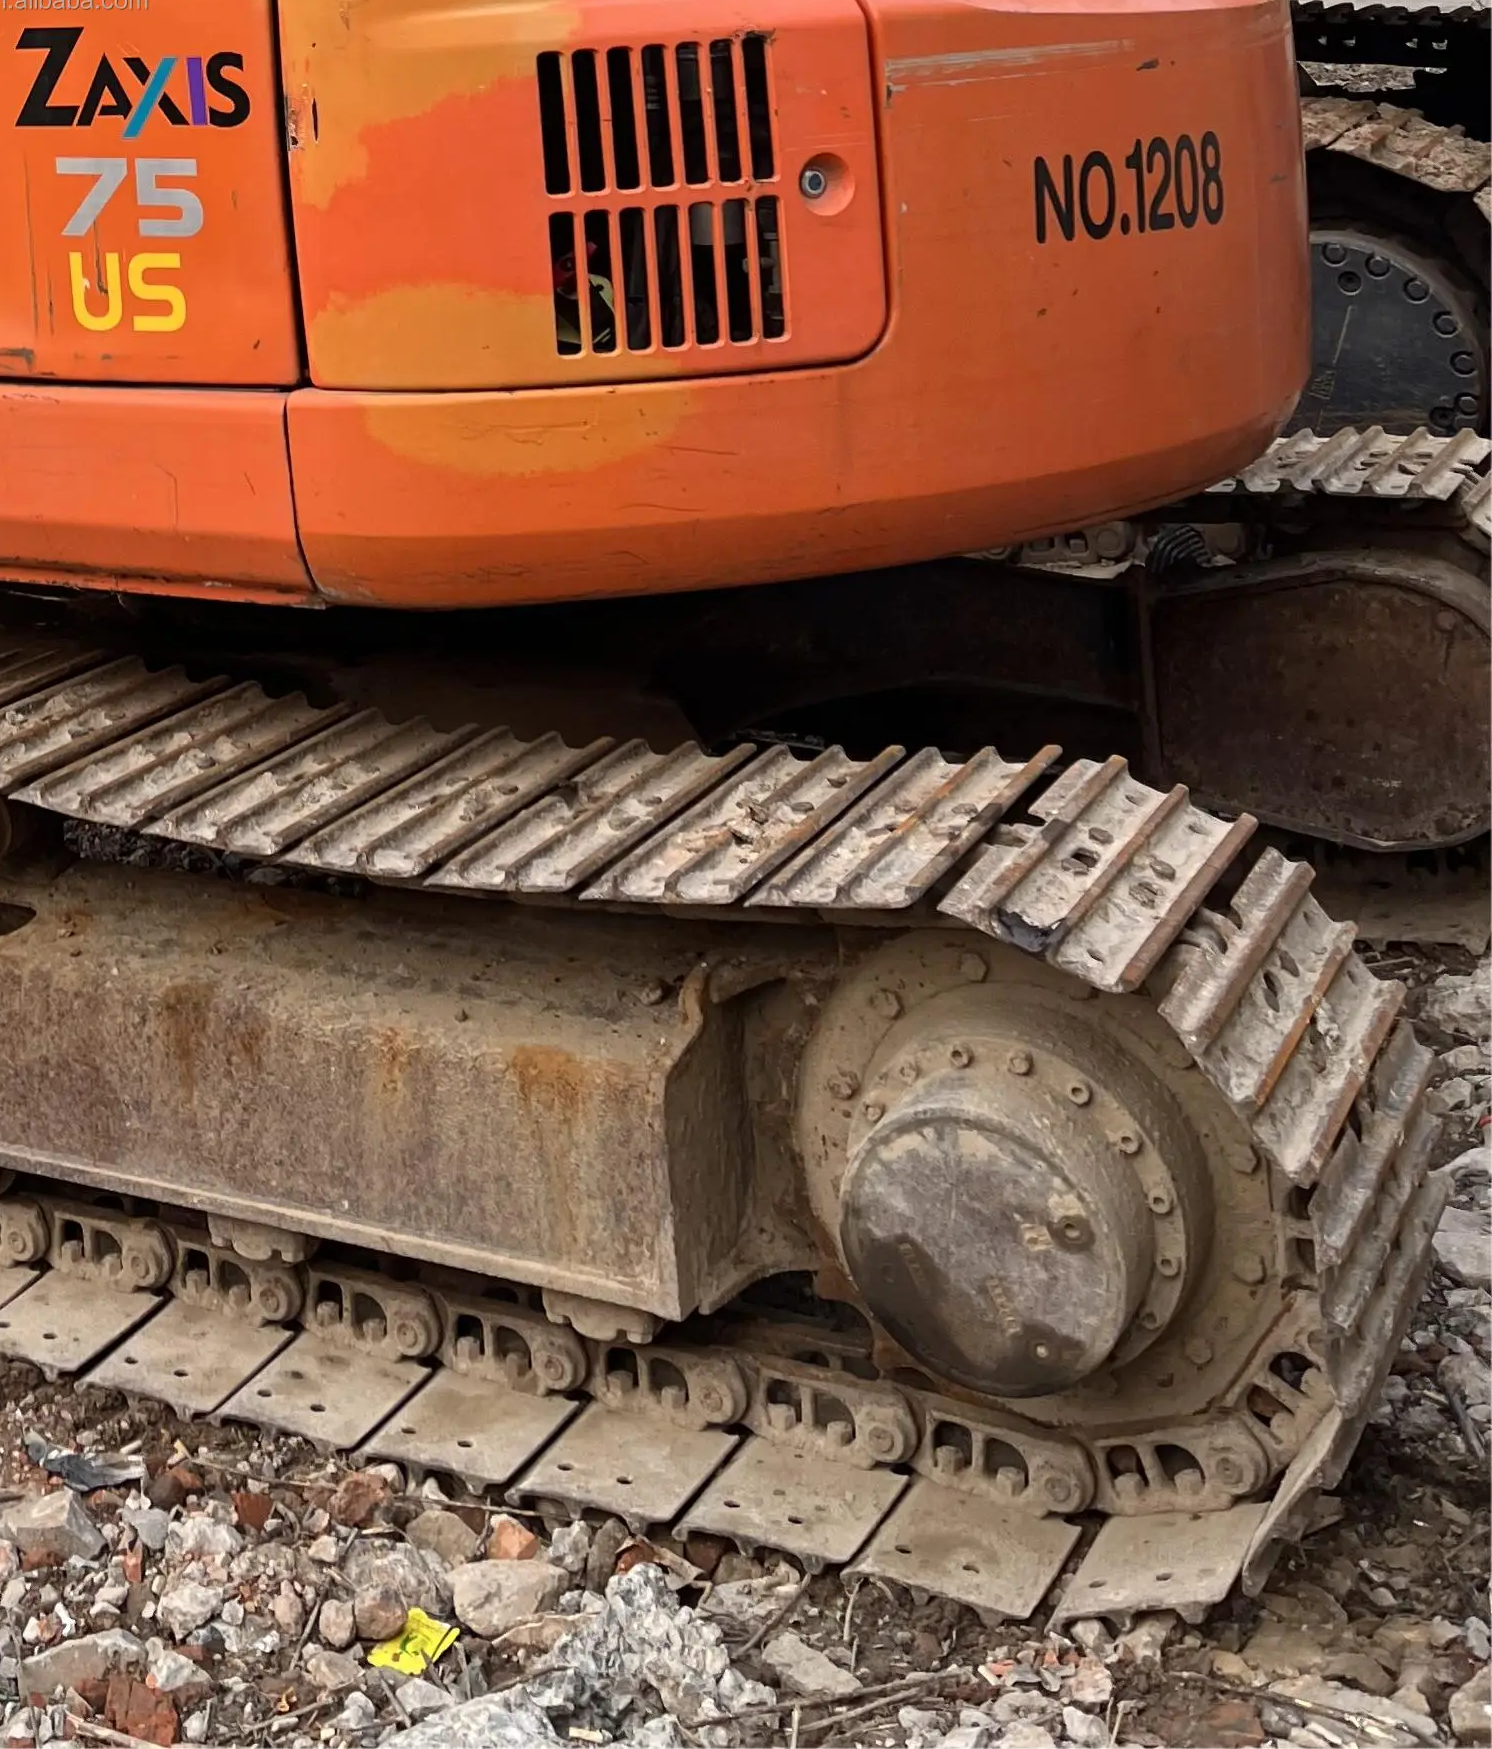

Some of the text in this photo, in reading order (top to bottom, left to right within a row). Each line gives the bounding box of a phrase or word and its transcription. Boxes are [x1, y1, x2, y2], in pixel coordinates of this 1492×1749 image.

[15, 27, 251, 139] ZAXIS
[55, 158, 203, 237] 75
[1034, 130, 1224, 244] NO.1208
[70, 253, 187, 332] US
